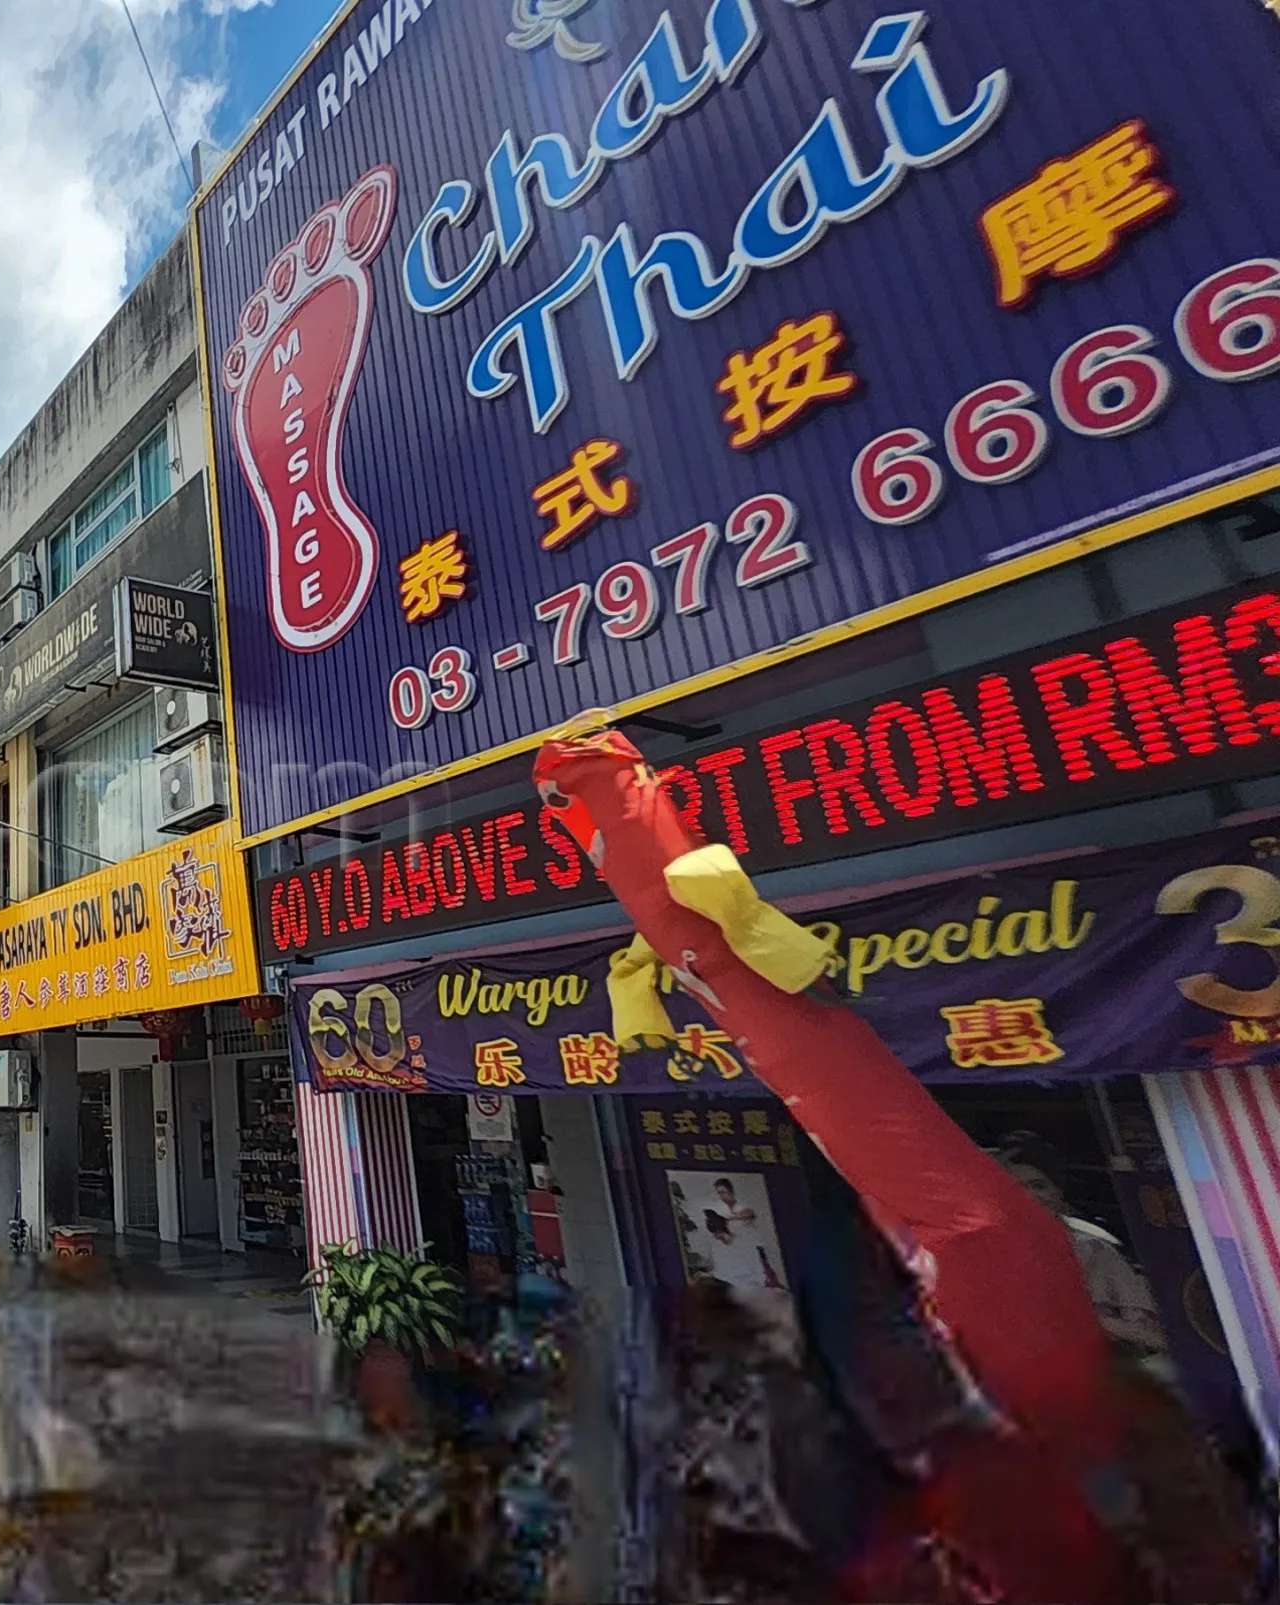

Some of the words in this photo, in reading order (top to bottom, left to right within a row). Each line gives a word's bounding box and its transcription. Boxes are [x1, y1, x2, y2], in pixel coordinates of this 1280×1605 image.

[220, 107, 308, 248] PUSAT
[317, 0, 433, 134] RAWA
[466, 9, 1009, 434] Thai
[398, 116, 1177, 627] 泰式按摩
[850, 257, 1280, 527] 6666
[270, 327, 323, 610] MASSAGE
[23, 602, 99, 687] WORLDWIDE
[132, 590, 185, 620] WORLD
[133, 612, 173, 639] WIDE
[270, 875, 308, 952] 60
[381, 810, 539, 924] ABOVE
[758, 673, 1046, 845] FROM
[50, 908, 68, 955] TY
[72, 900, 107, 951] SDN.
[111, 882, 151, 940] BHD.
[308, 983, 407, 1073] 60
[437, 967, 589, 1028] Warga
[345, 1066, 365, 1078] Old
